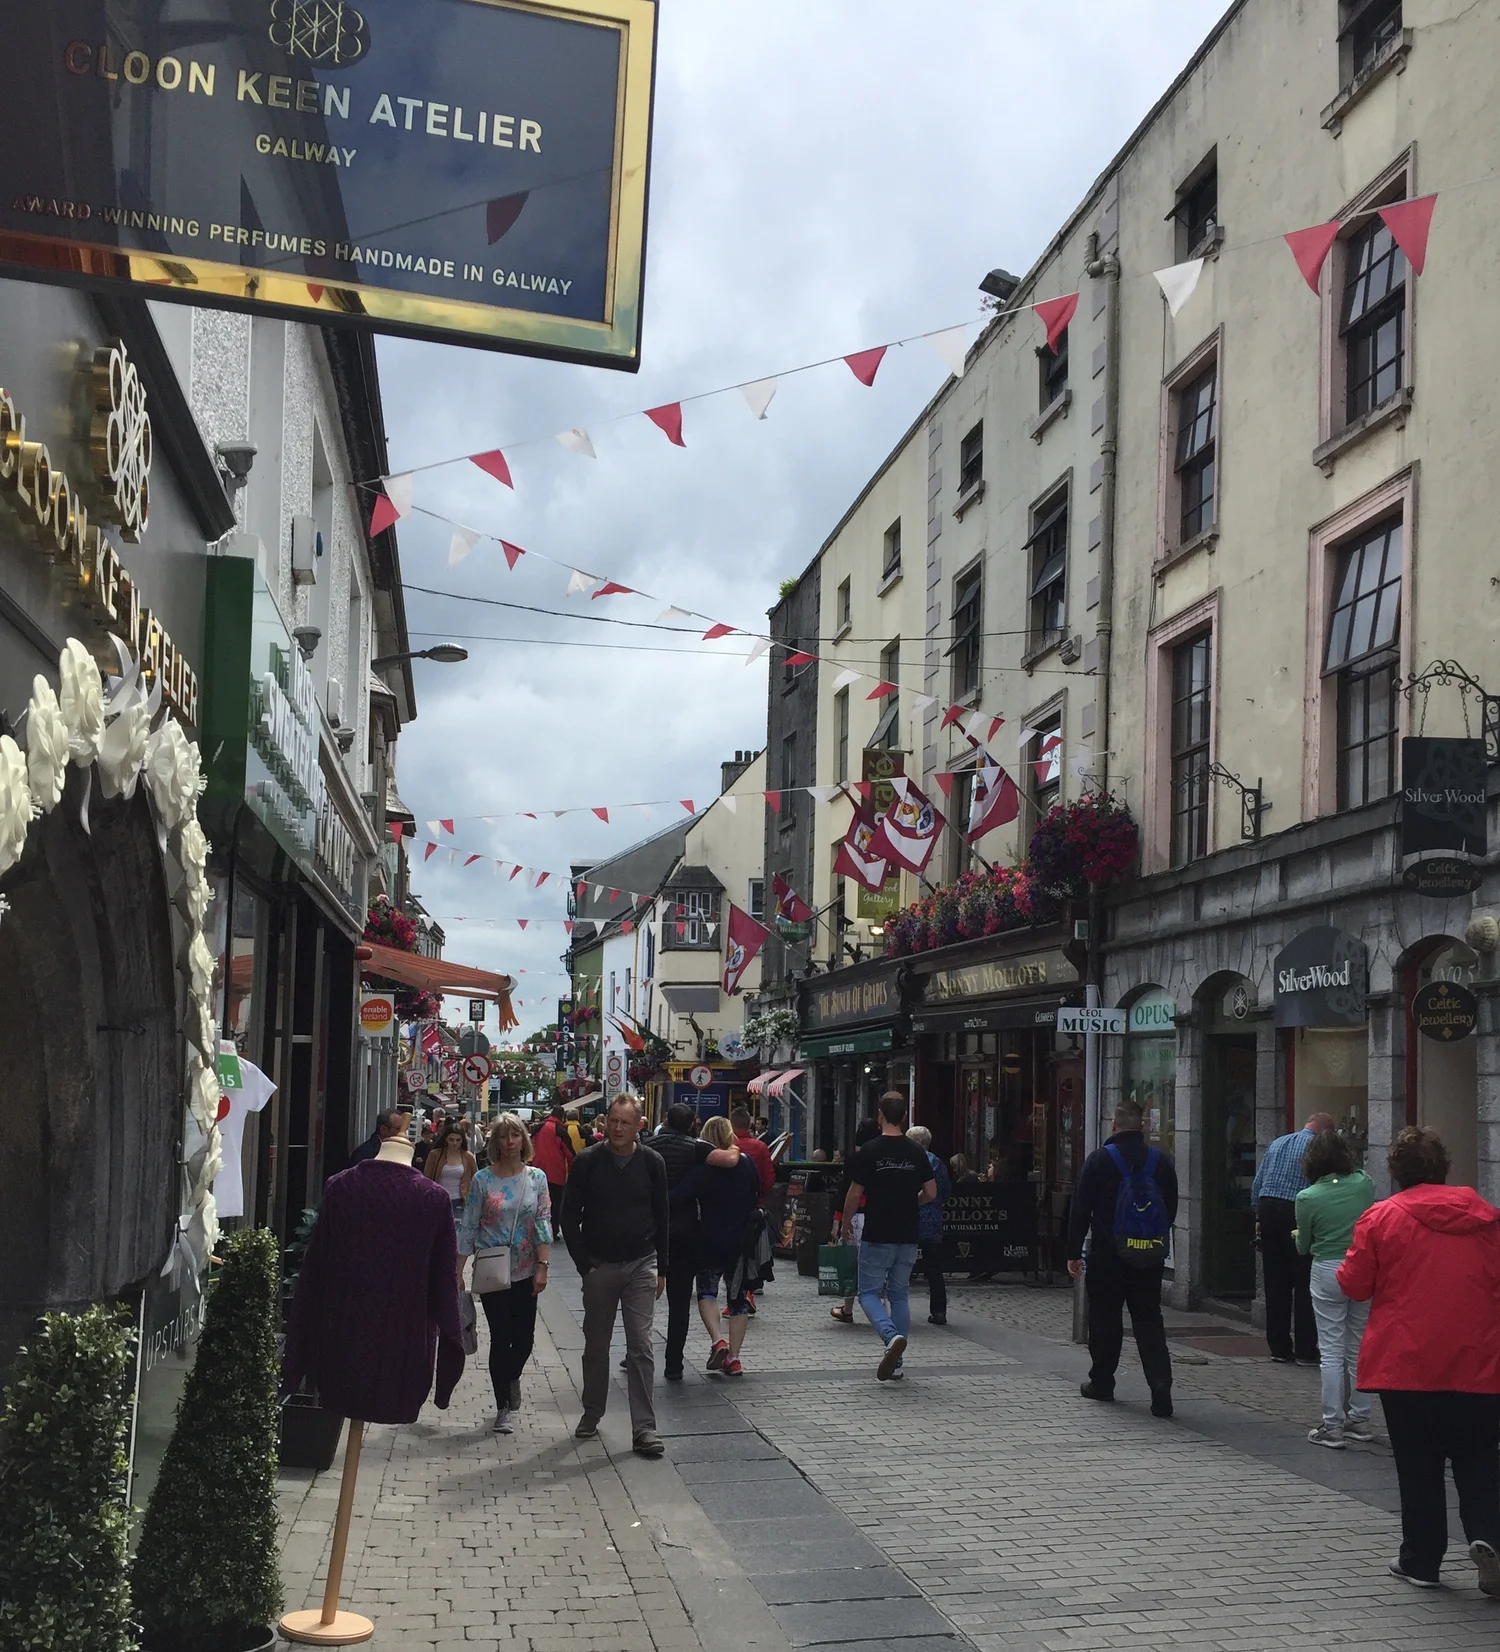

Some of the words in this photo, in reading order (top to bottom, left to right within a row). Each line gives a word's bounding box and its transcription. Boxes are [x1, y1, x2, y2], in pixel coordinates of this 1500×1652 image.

[64, 40, 216, 96] CLOON
[236, 69, 351, 119] KEEN
[369, 93, 543, 153] ATELIER
[255, 133, 357, 168] GALWAY
[209, 223, 327, 256] PERFUMES
[334, 240, 456, 278] HANDMADE
[463, 263, 484, 282] IN
[492, 268, 573, 296] GALWAY
[142, 608, 199, 728] ATELIER
[1404, 787, 1443, 803] Silver
[1444, 789, 1486, 804] Wood
[1427, 862, 1460, 874] Celtic
[863, 893, 894, 908] Gallery
[1428, 997, 1462, 1010] Celtic
[1079, 1008, 1103, 1018] CEOL
[1134, 1003, 1170, 1025] OPUS
[1062, 1017, 1120, 1032] MUSIC
[941, 1196, 994, 1208] ONNY
[941, 1209, 1008, 1221] OLLOY'S
[1127, 1237, 1154, 1250] PUMA
[146, 1304, 195, 1371] UPSTAIRS
